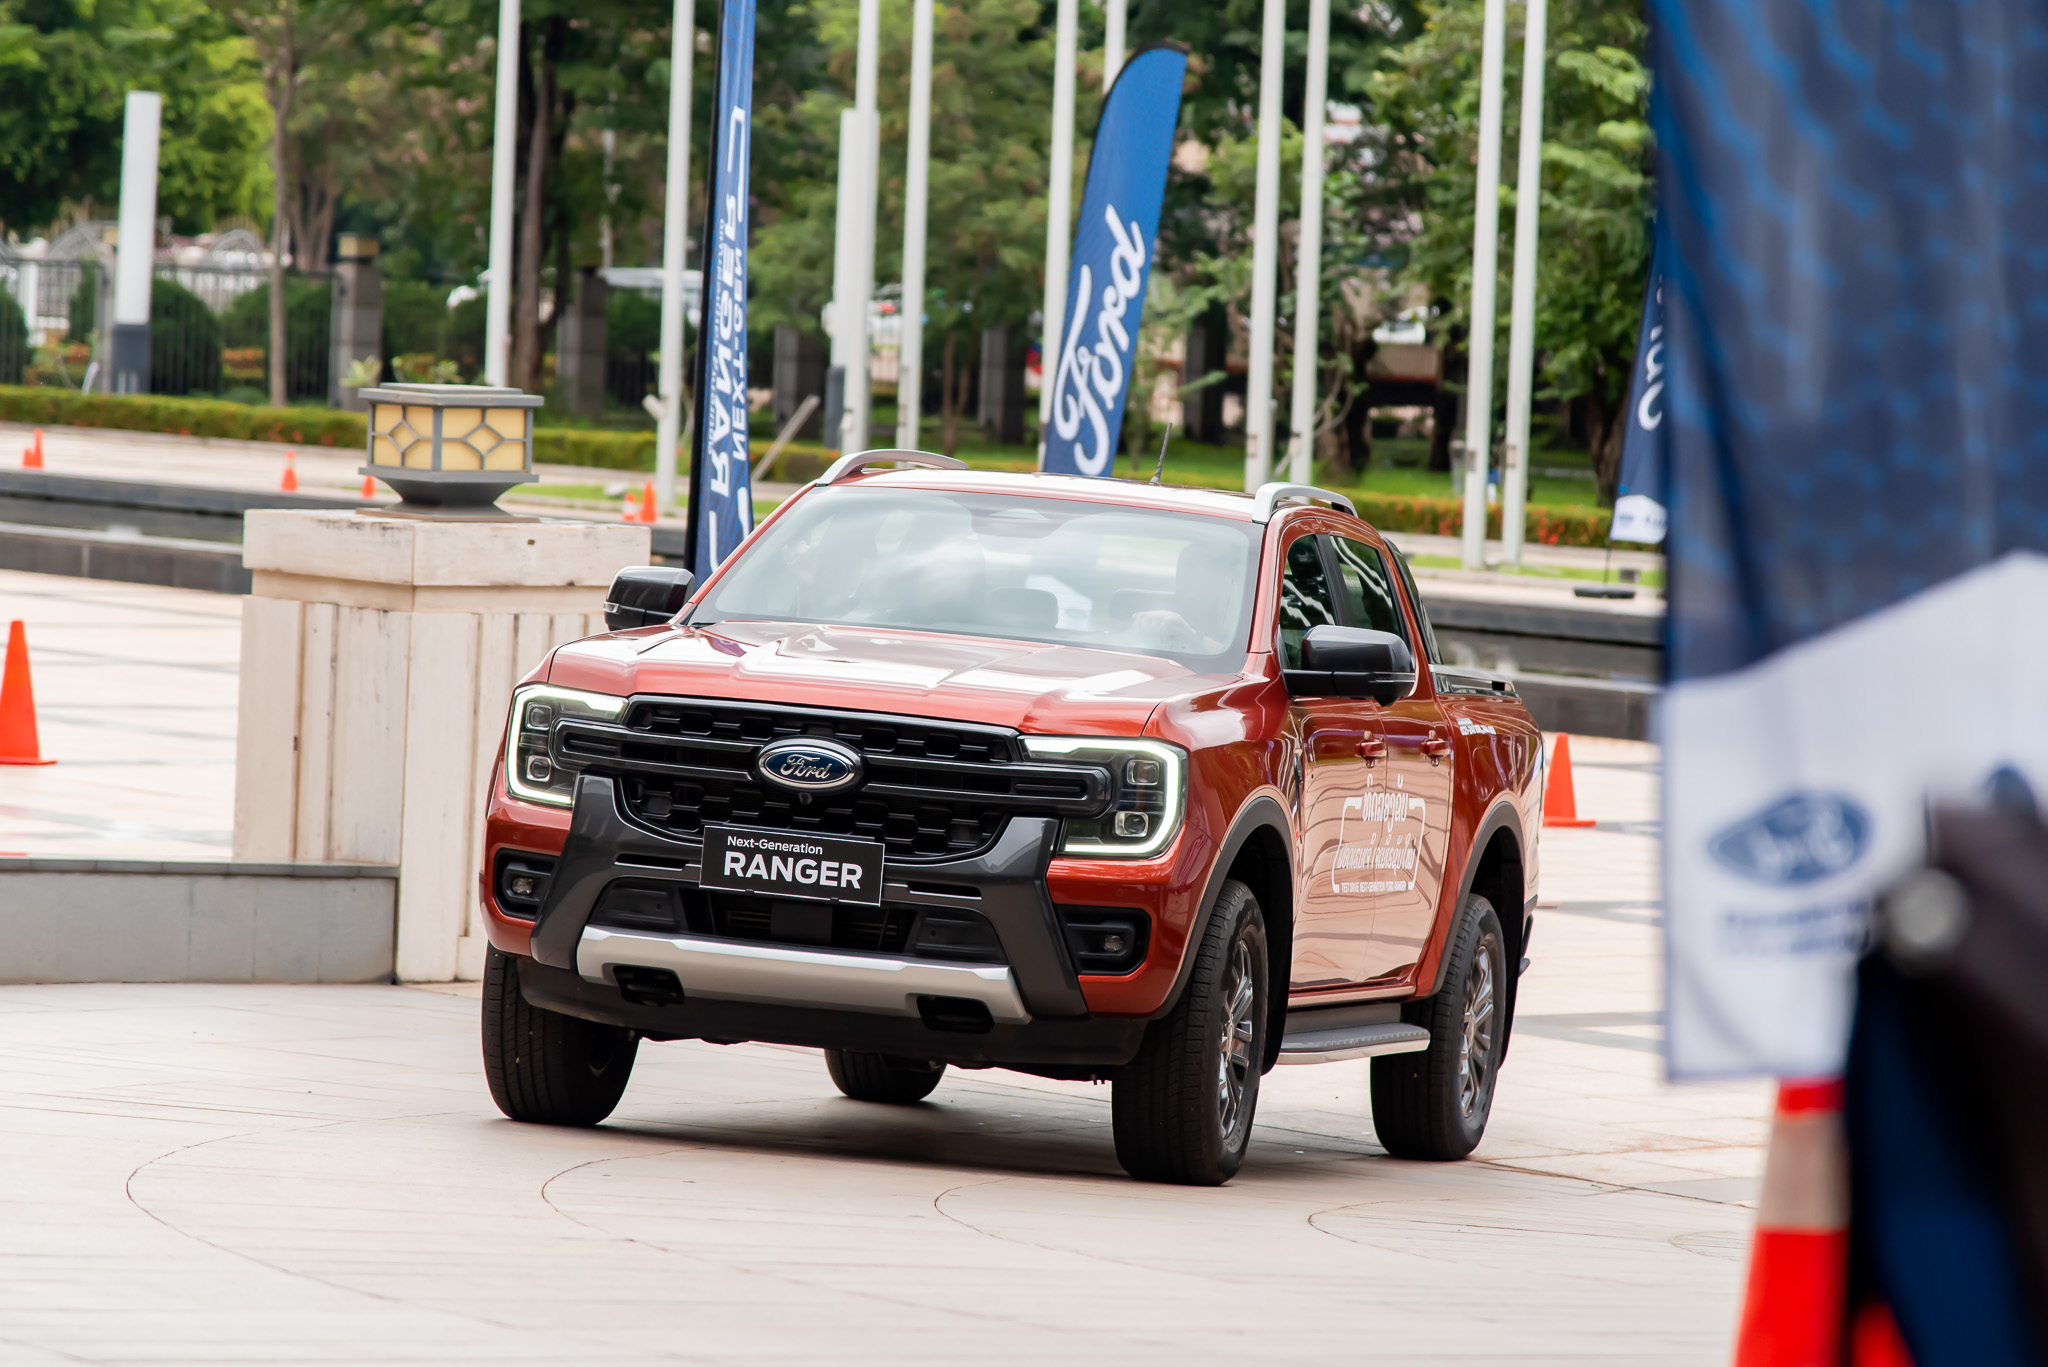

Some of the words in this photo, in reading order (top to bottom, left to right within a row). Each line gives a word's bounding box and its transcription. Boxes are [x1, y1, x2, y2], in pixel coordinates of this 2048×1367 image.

[1054, 204, 1146, 476] Ford
[780, 753, 832, 780] Ford
[727, 836, 823, 855] Next-Generation
[724, 851, 862, 889] RANGER
